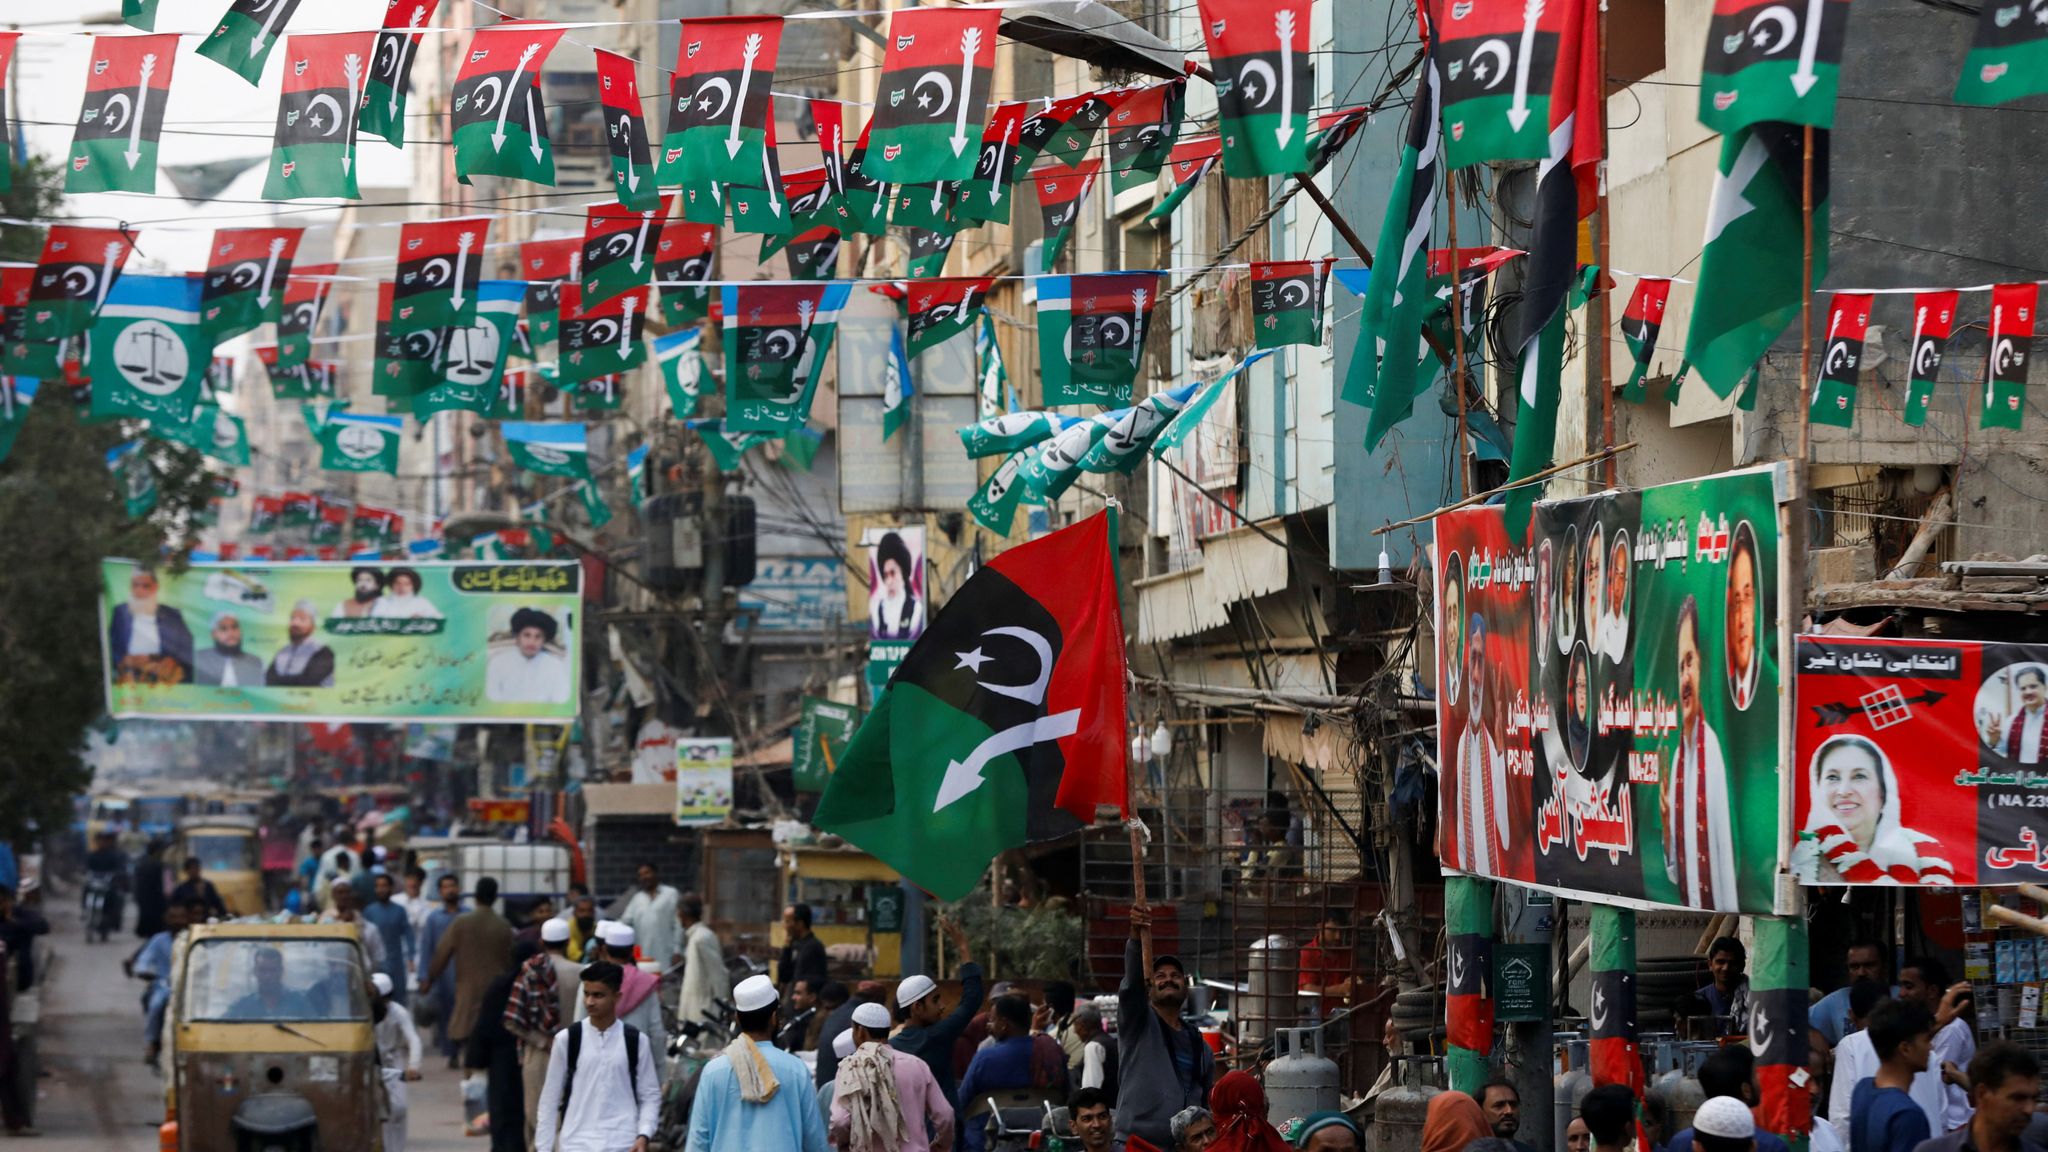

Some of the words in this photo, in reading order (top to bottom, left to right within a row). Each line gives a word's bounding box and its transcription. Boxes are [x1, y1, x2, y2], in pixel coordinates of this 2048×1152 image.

[1839, 652, 1884, 670] نشان
[1886, 653, 1956, 672] انتخابی
[1508, 749, 1534, 776] PS-106
[1628, 752, 1659, 782] NA-239
[1998, 794, 2024, 806] NA
